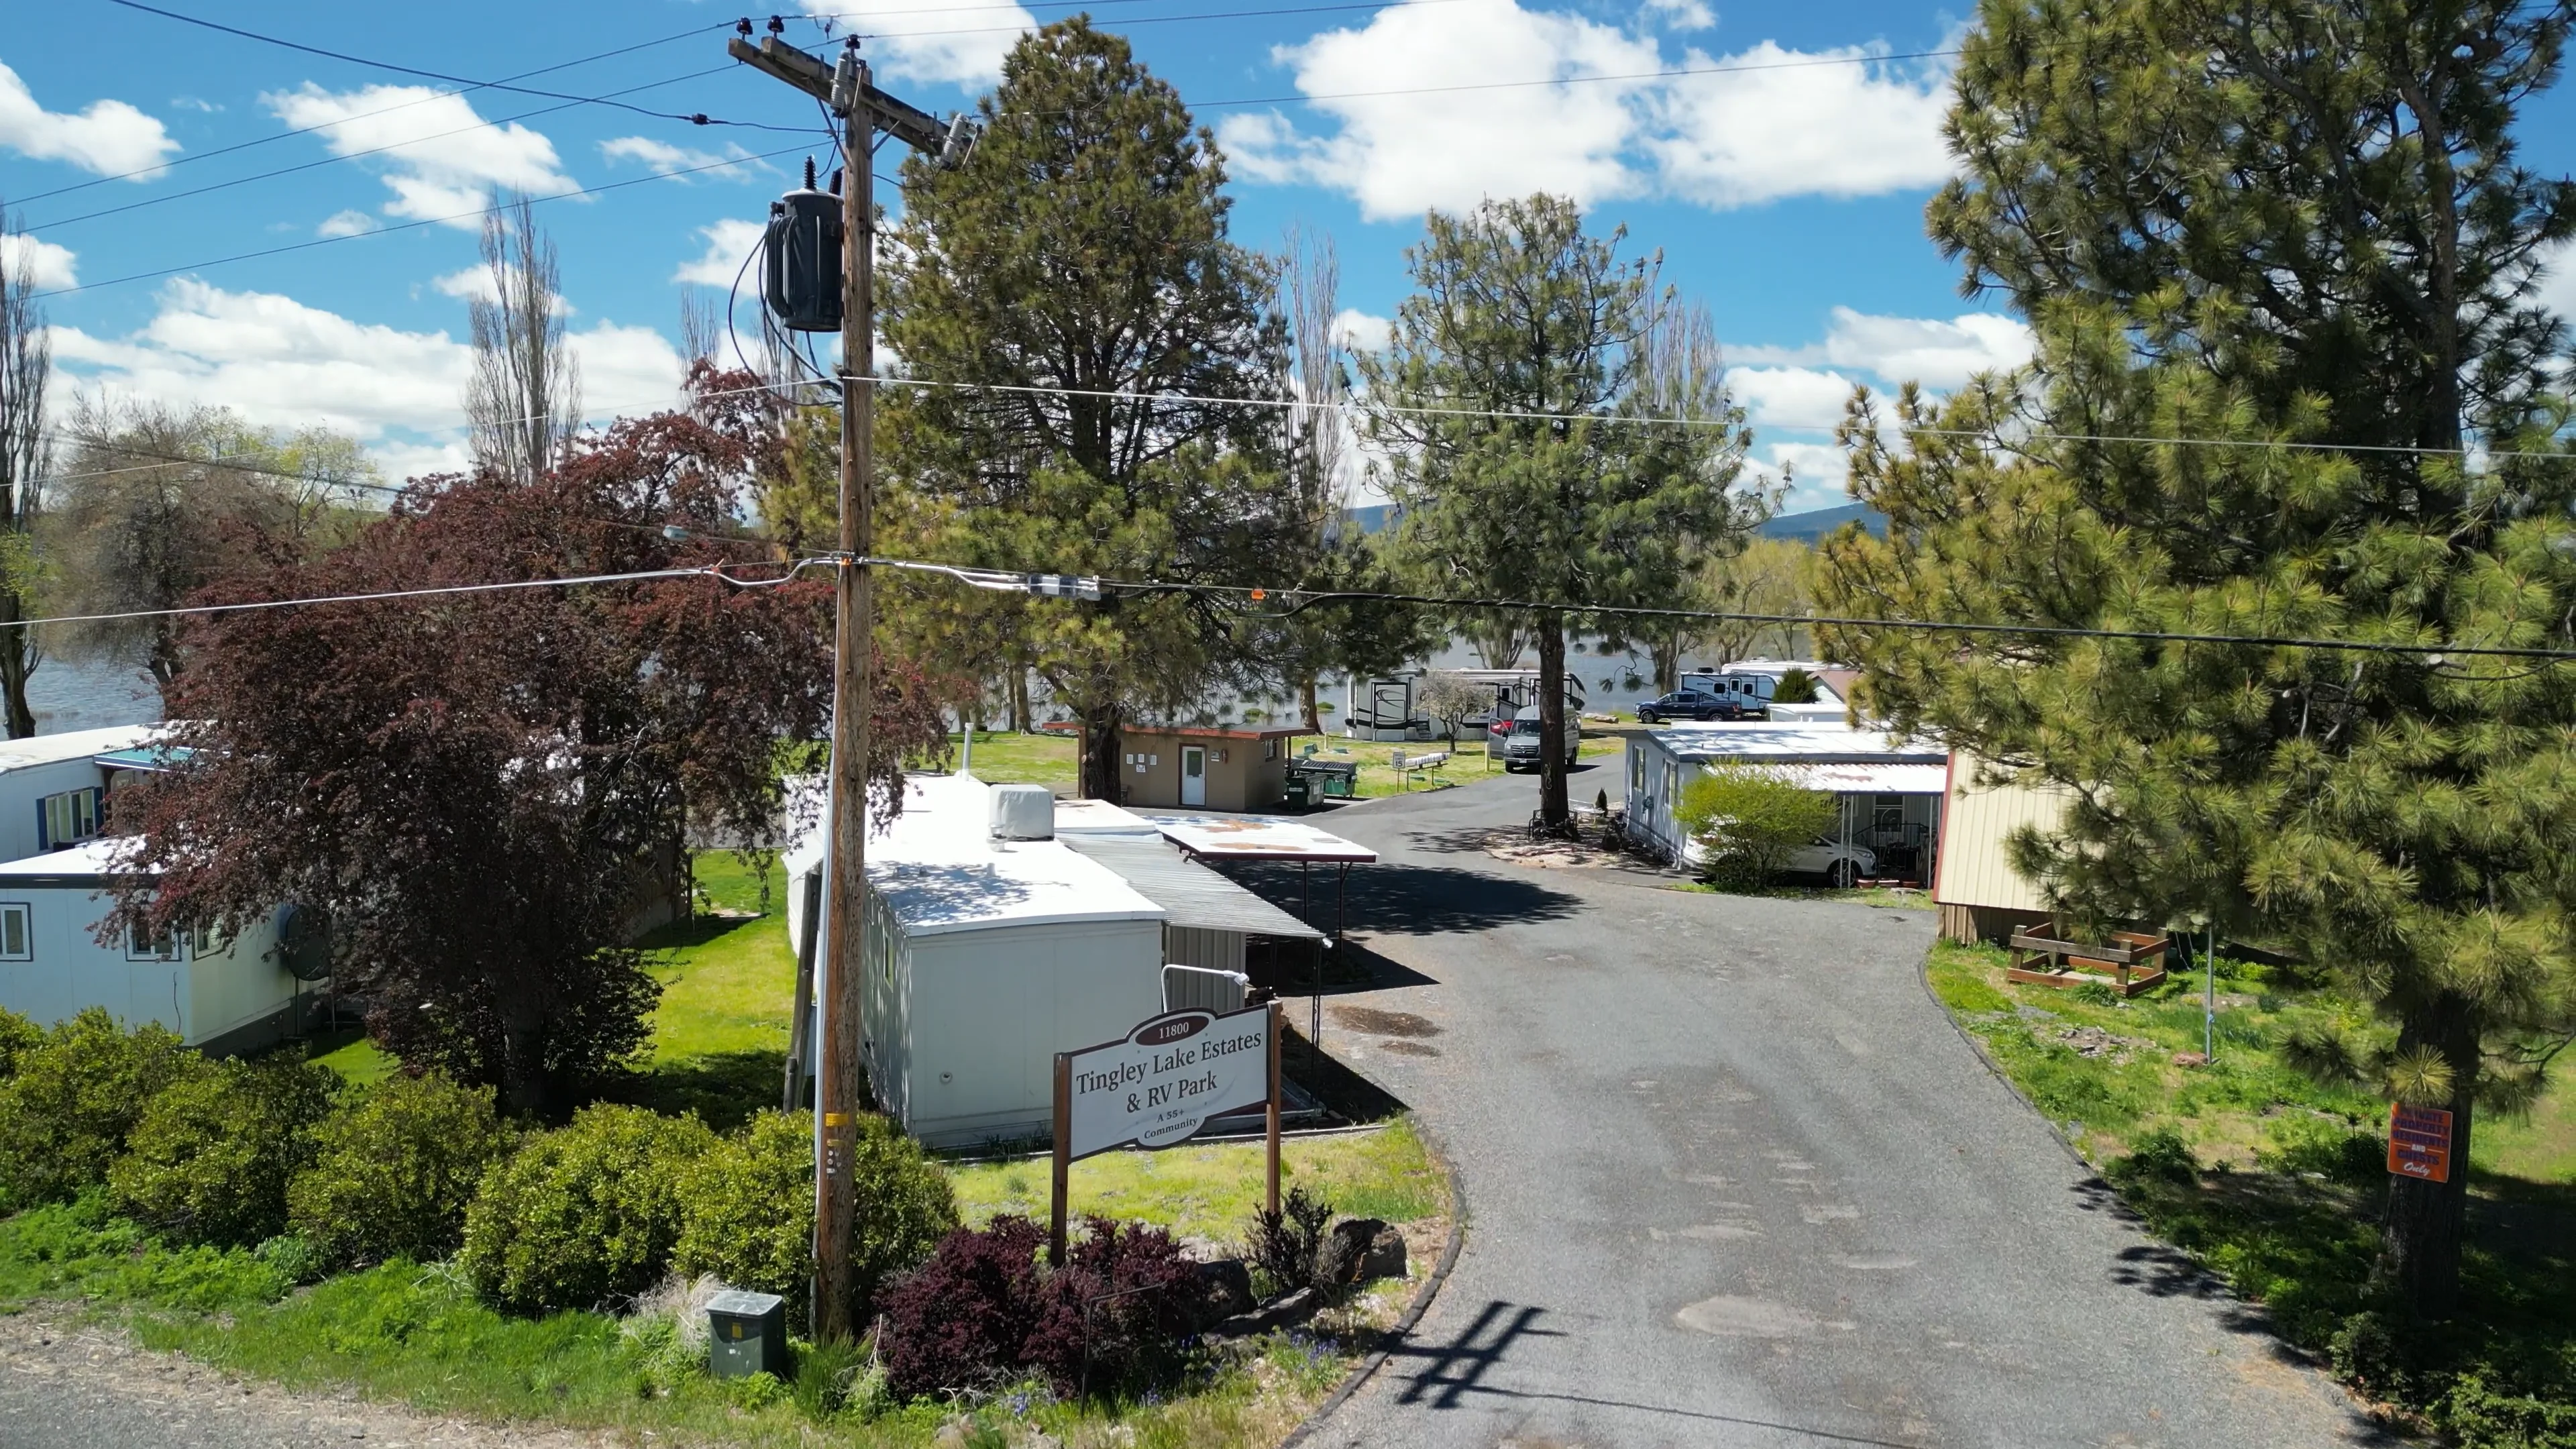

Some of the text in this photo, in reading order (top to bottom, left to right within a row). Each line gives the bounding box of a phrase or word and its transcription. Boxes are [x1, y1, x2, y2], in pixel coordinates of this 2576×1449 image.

[1159, 1022, 1189, 1039] 11800
[1076, 1032, 1261, 1095] Tingley Lake Estates
[1127, 1070, 1218, 1113] & RV Park
[1157, 1108, 1185, 1123] A 55+
[1144, 1118, 1197, 1139] Community
[2394, 1117, 2449, 1136] PROPERTY
[2393, 1130, 2449, 1148] RESIDENTS
[2412, 1144, 2426, 1152] AND
[2398, 1149, 2440, 1166] GUESTS
[2404, 1162, 2431, 1177] Only
